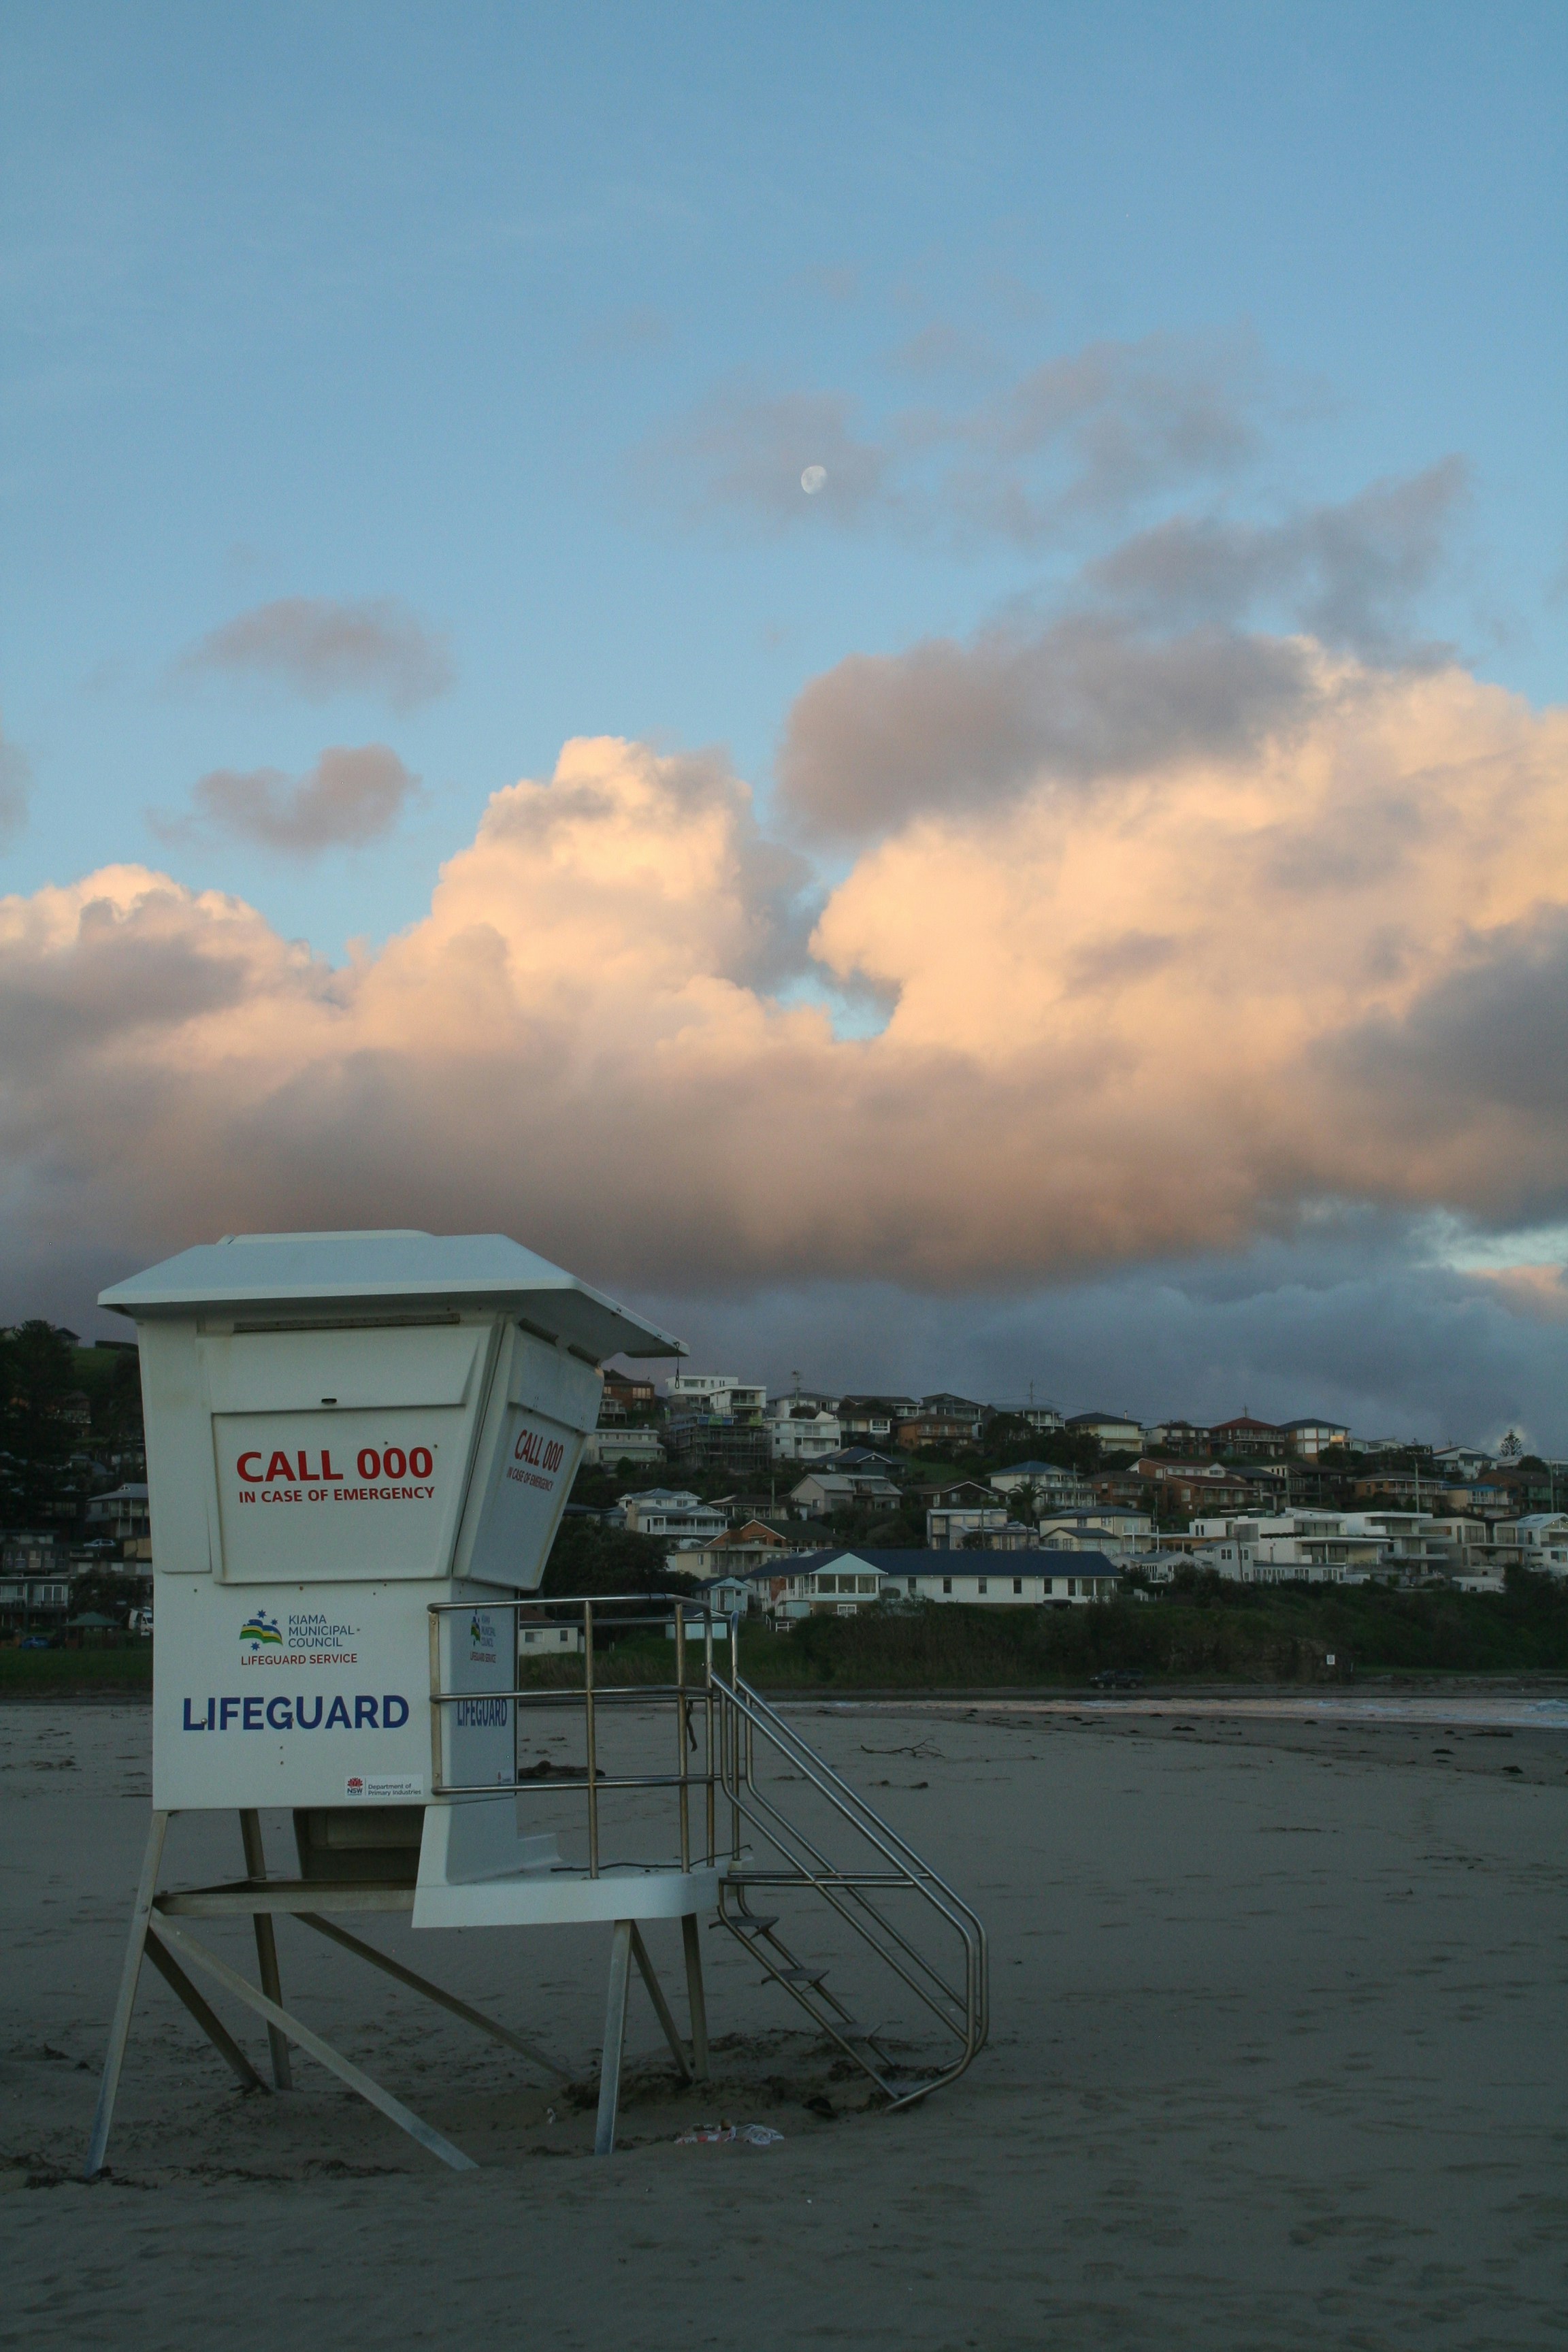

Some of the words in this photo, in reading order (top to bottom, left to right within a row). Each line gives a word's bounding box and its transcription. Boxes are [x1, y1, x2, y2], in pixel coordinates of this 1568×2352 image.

[514, 1429, 543, 1467] CALL
[542, 1440, 564, 1473] 000
[237, 1450, 344, 1482] CALL
[357, 1447, 433, 1480] 000
[512, 1468, 526, 1482] CASE
[240, 1491, 256, 1503] IN
[261, 1490, 303, 1503] CASE
[308, 1489, 328, 1501] OF
[333, 1486, 435, 1501] EMERGENCY
[289, 1614, 327, 1625] KIAMA
[289, 1625, 355, 1637] MUNICIPAL
[288, 1637, 343, 1648] COUNCIL
[241, 1654, 306, 1665] LIFEGUARD
[309, 1653, 358, 1664] SERVICE
[183, 1695, 410, 1731] LIFEGUARD
[457, 1699, 508, 1727] LIFEGUARD
